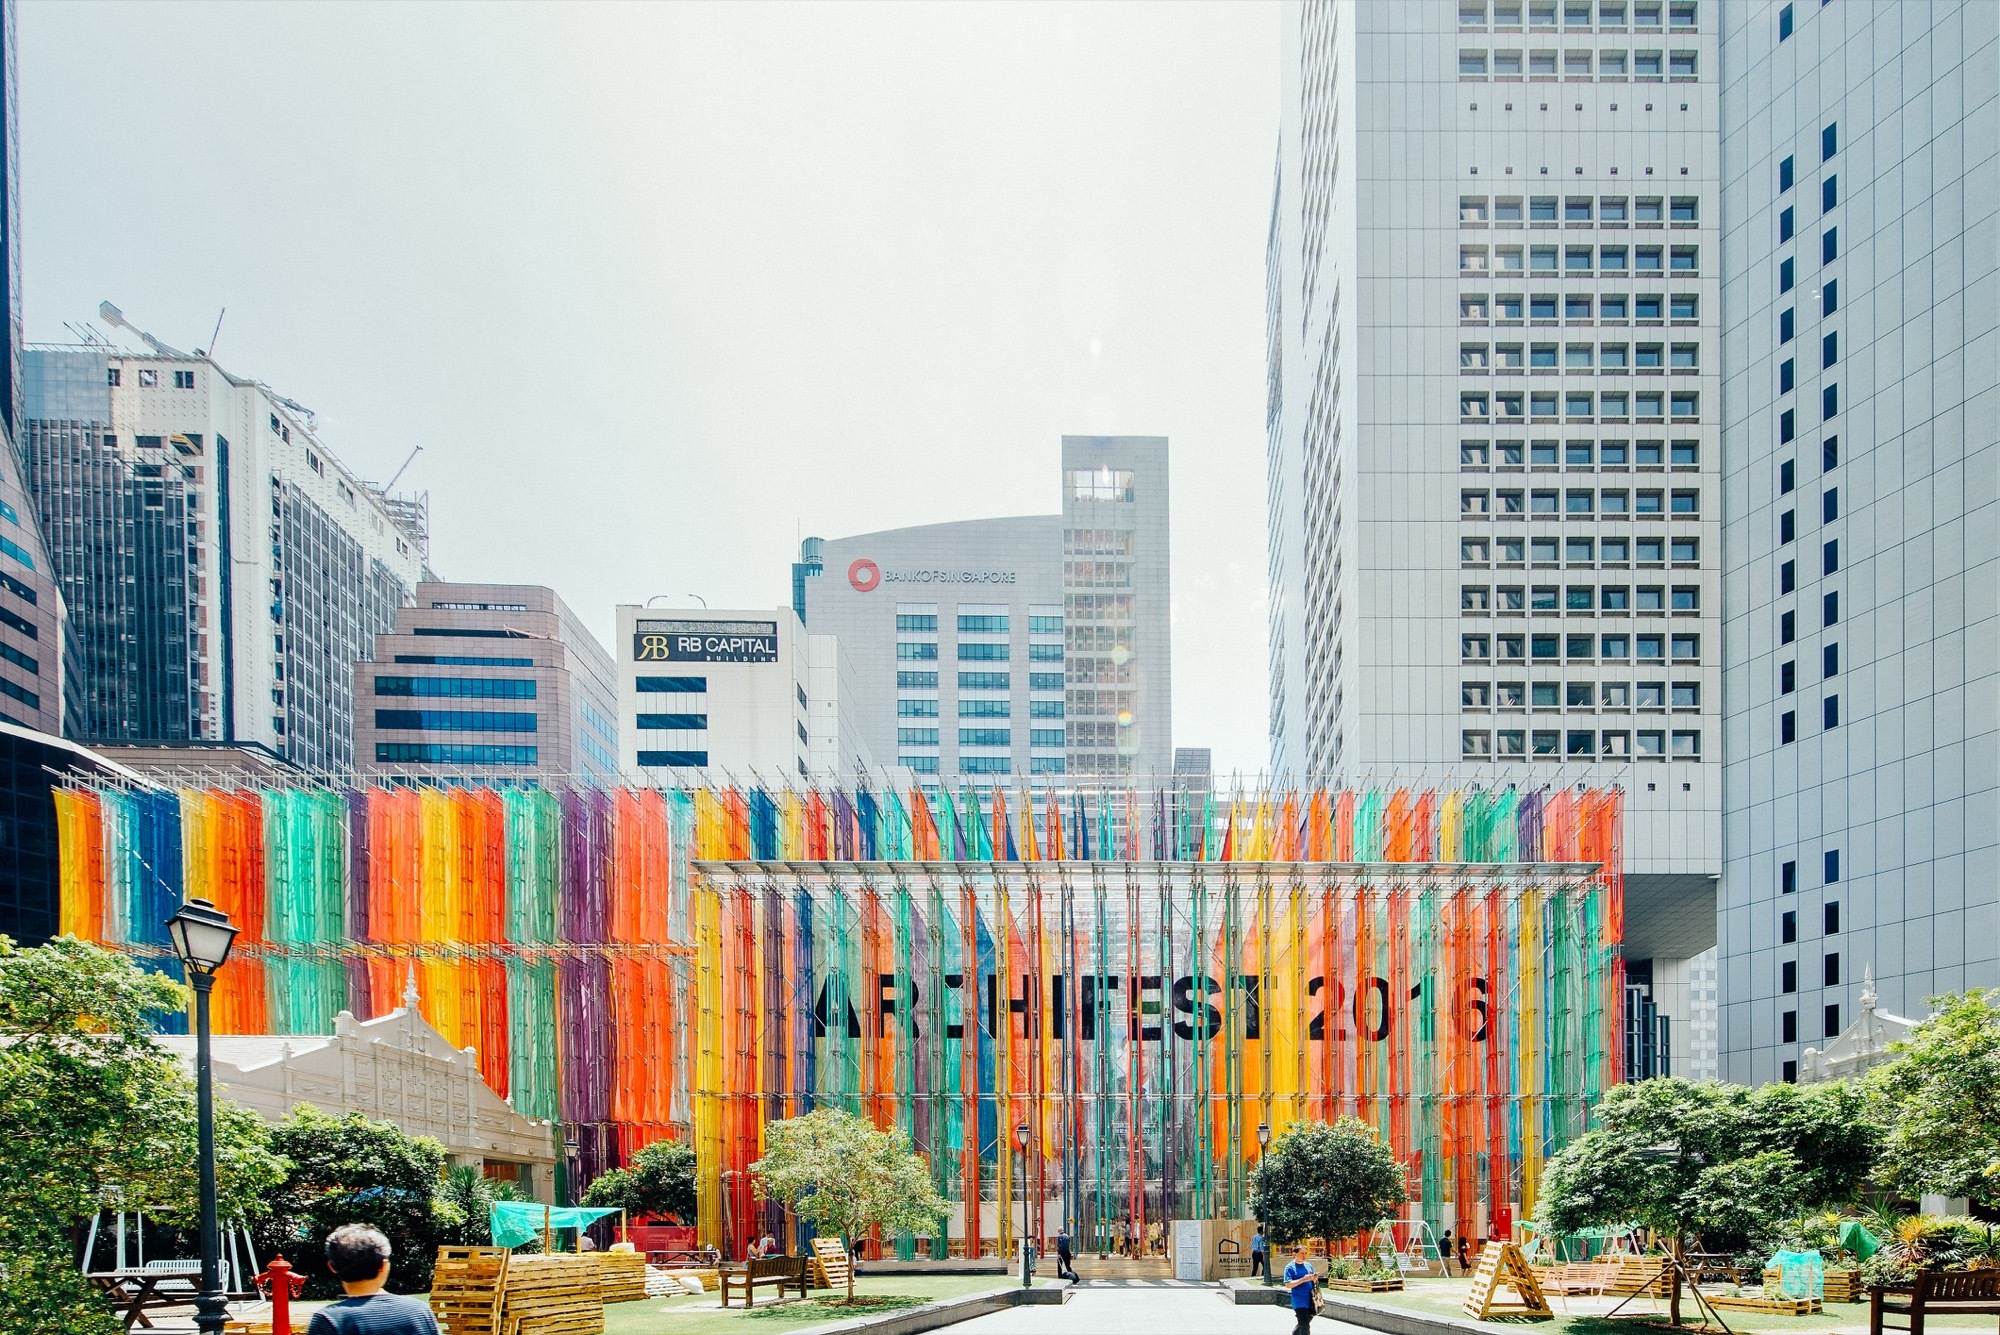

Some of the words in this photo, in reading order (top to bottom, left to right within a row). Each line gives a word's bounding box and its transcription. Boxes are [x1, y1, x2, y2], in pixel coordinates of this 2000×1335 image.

[678, 637, 702, 652] RB
[705, 638, 776, 653] CAPITAL
[1305, 976, 1494, 1042] 2016
